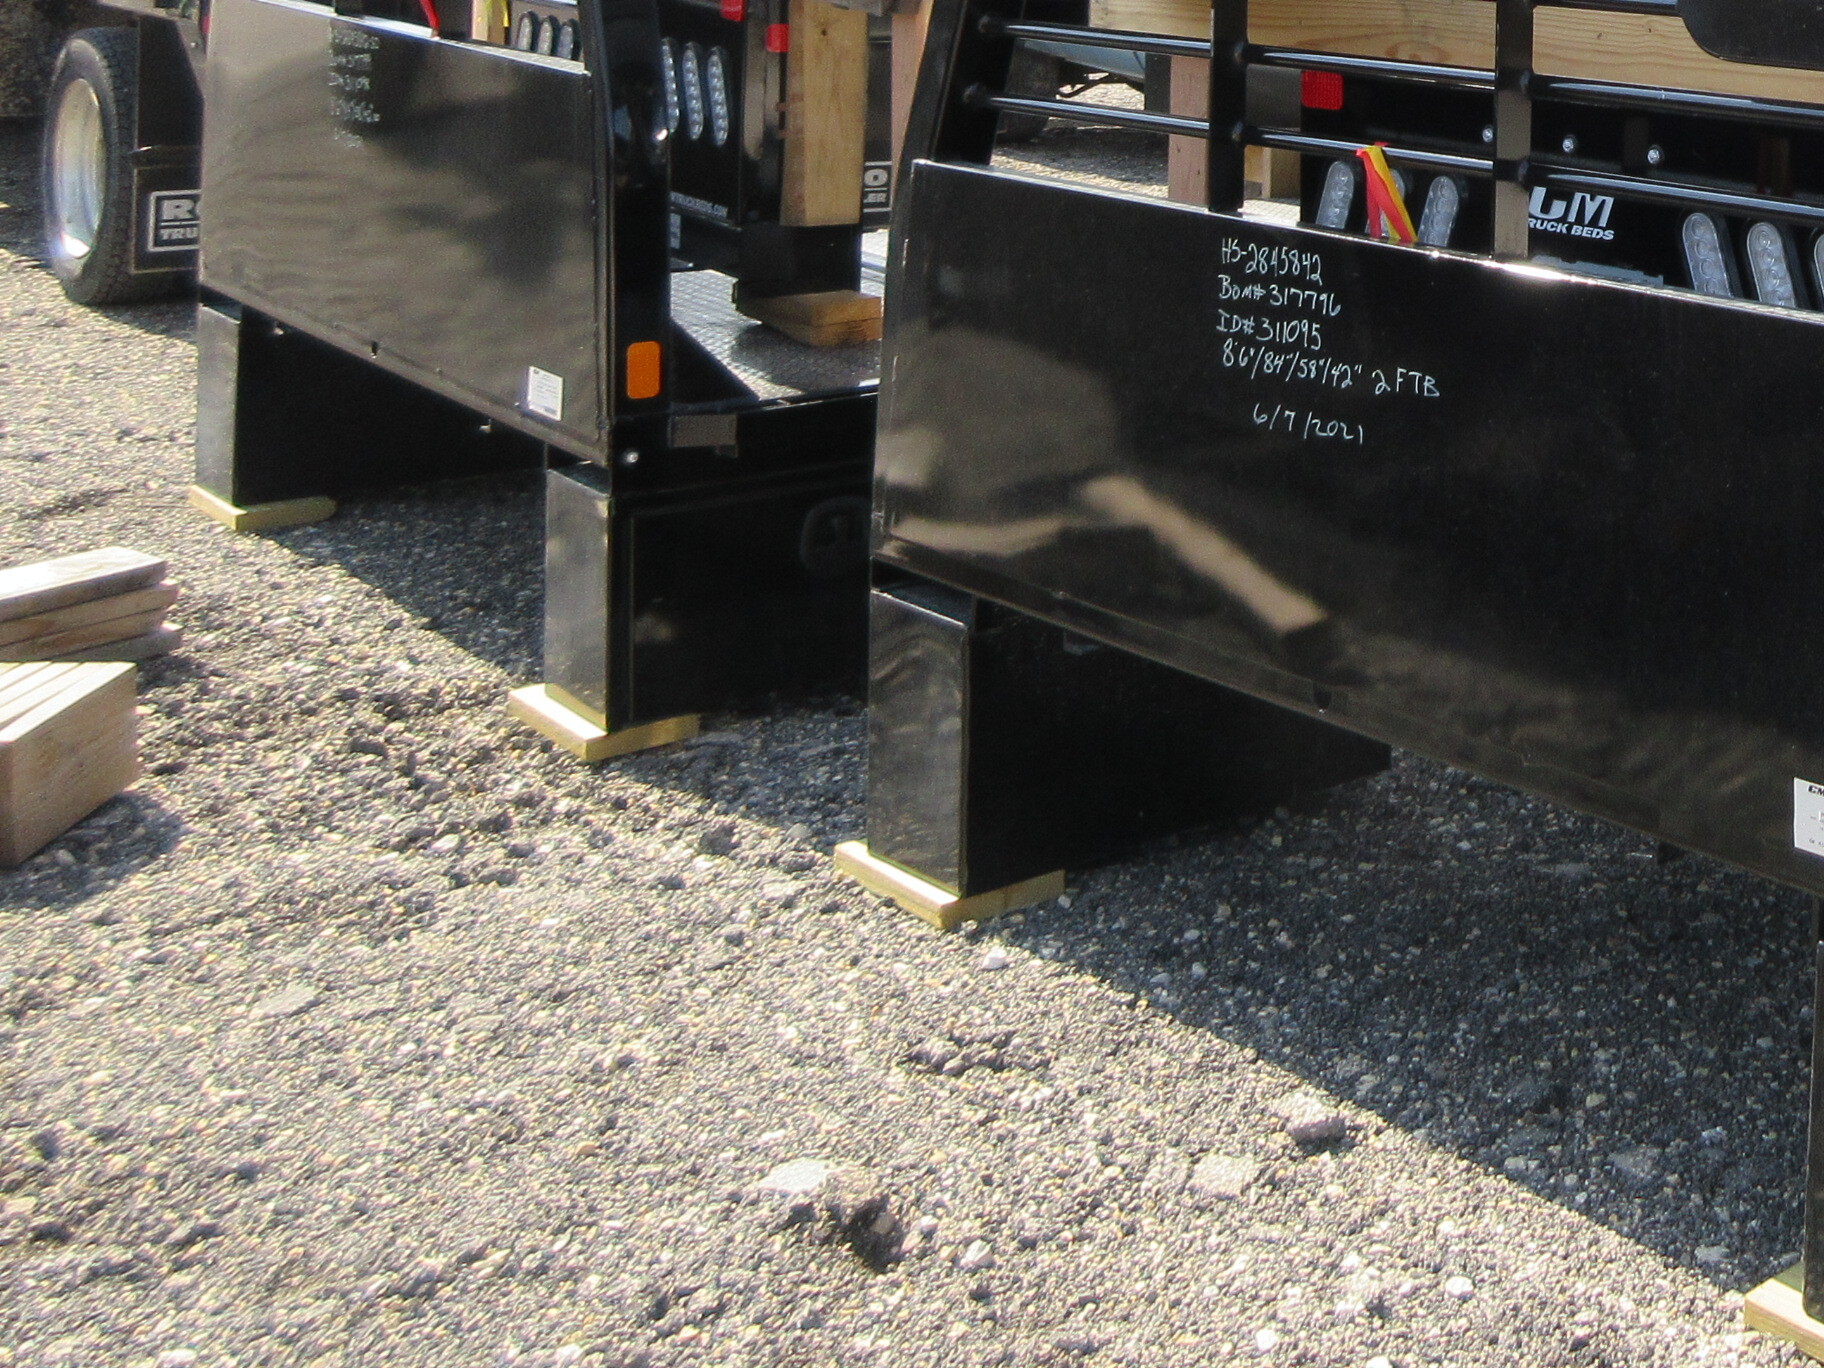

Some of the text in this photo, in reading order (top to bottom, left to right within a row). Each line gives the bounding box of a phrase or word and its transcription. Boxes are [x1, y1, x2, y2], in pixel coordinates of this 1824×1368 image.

[863, 168, 888, 186] O
[1528, 218, 1615, 241] RUCK BEDS
[1221, 237, 1323, 286] HS-2845842
